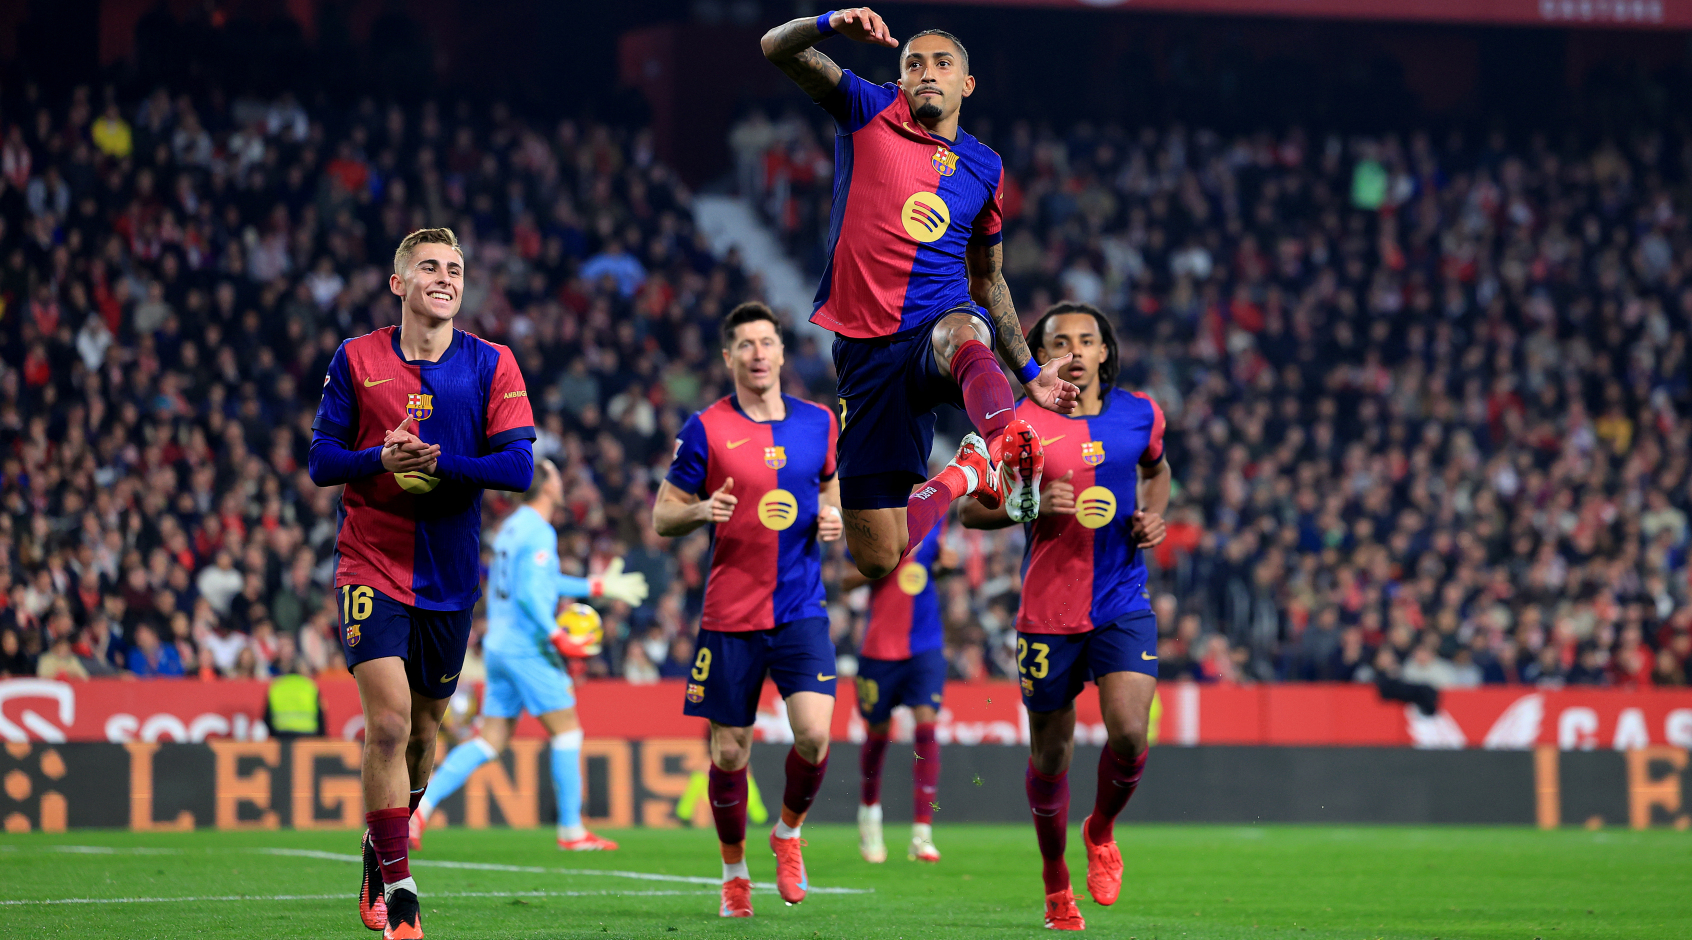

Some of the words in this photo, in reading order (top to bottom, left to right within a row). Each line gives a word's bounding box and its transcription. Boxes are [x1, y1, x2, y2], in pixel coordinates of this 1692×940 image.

[1018, 431, 1034, 520] PREDATOR
[342, 584, 375, 624] 16
[691, 647, 712, 682] 9
[1017, 637, 1050, 679] 23
